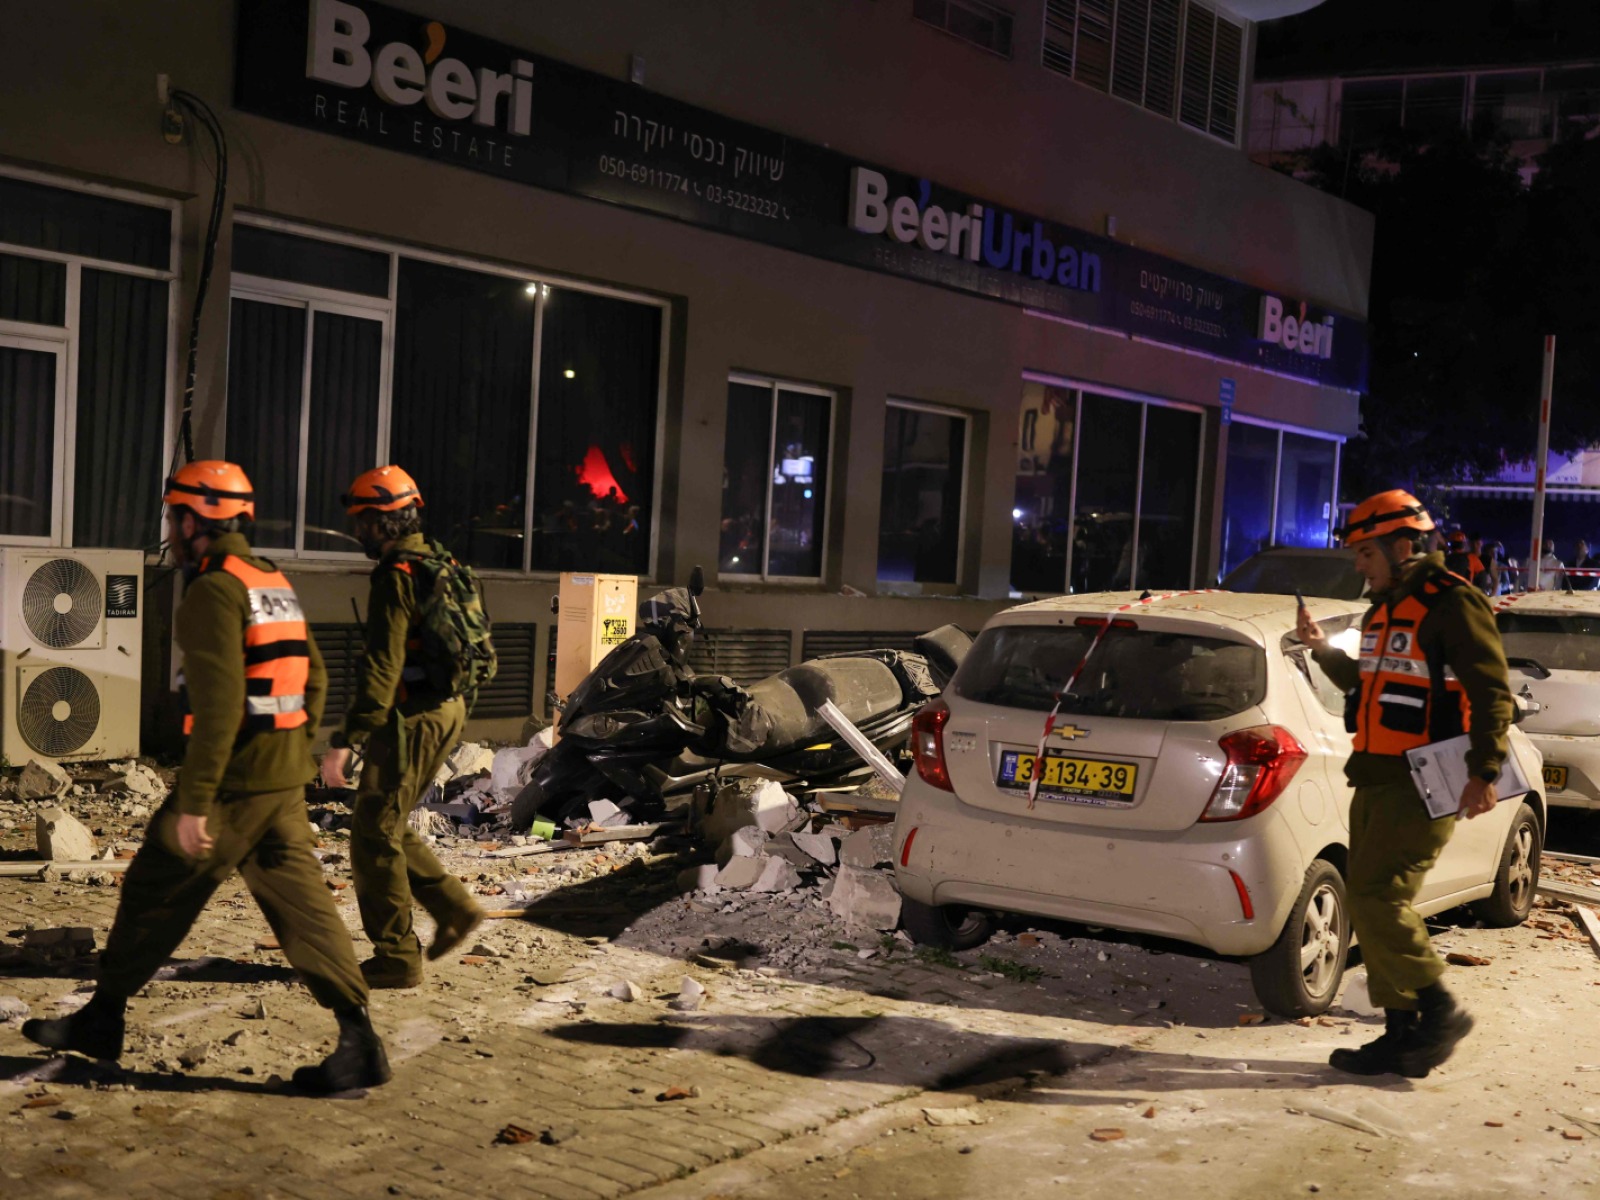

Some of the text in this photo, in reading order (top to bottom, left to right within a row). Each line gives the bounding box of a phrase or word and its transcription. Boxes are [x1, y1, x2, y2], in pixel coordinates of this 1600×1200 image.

[306, 0, 534, 136] Be'eri
[315, 94, 513, 167] REAL ESTATE
[614, 110, 785, 182] שיווק נכסי יוקרה
[599, 154, 779, 219] 050-6911774 03-5223232
[1257, 295, 1334, 359] Be'eri
[107, 608, 136, 616] TADIRAN
